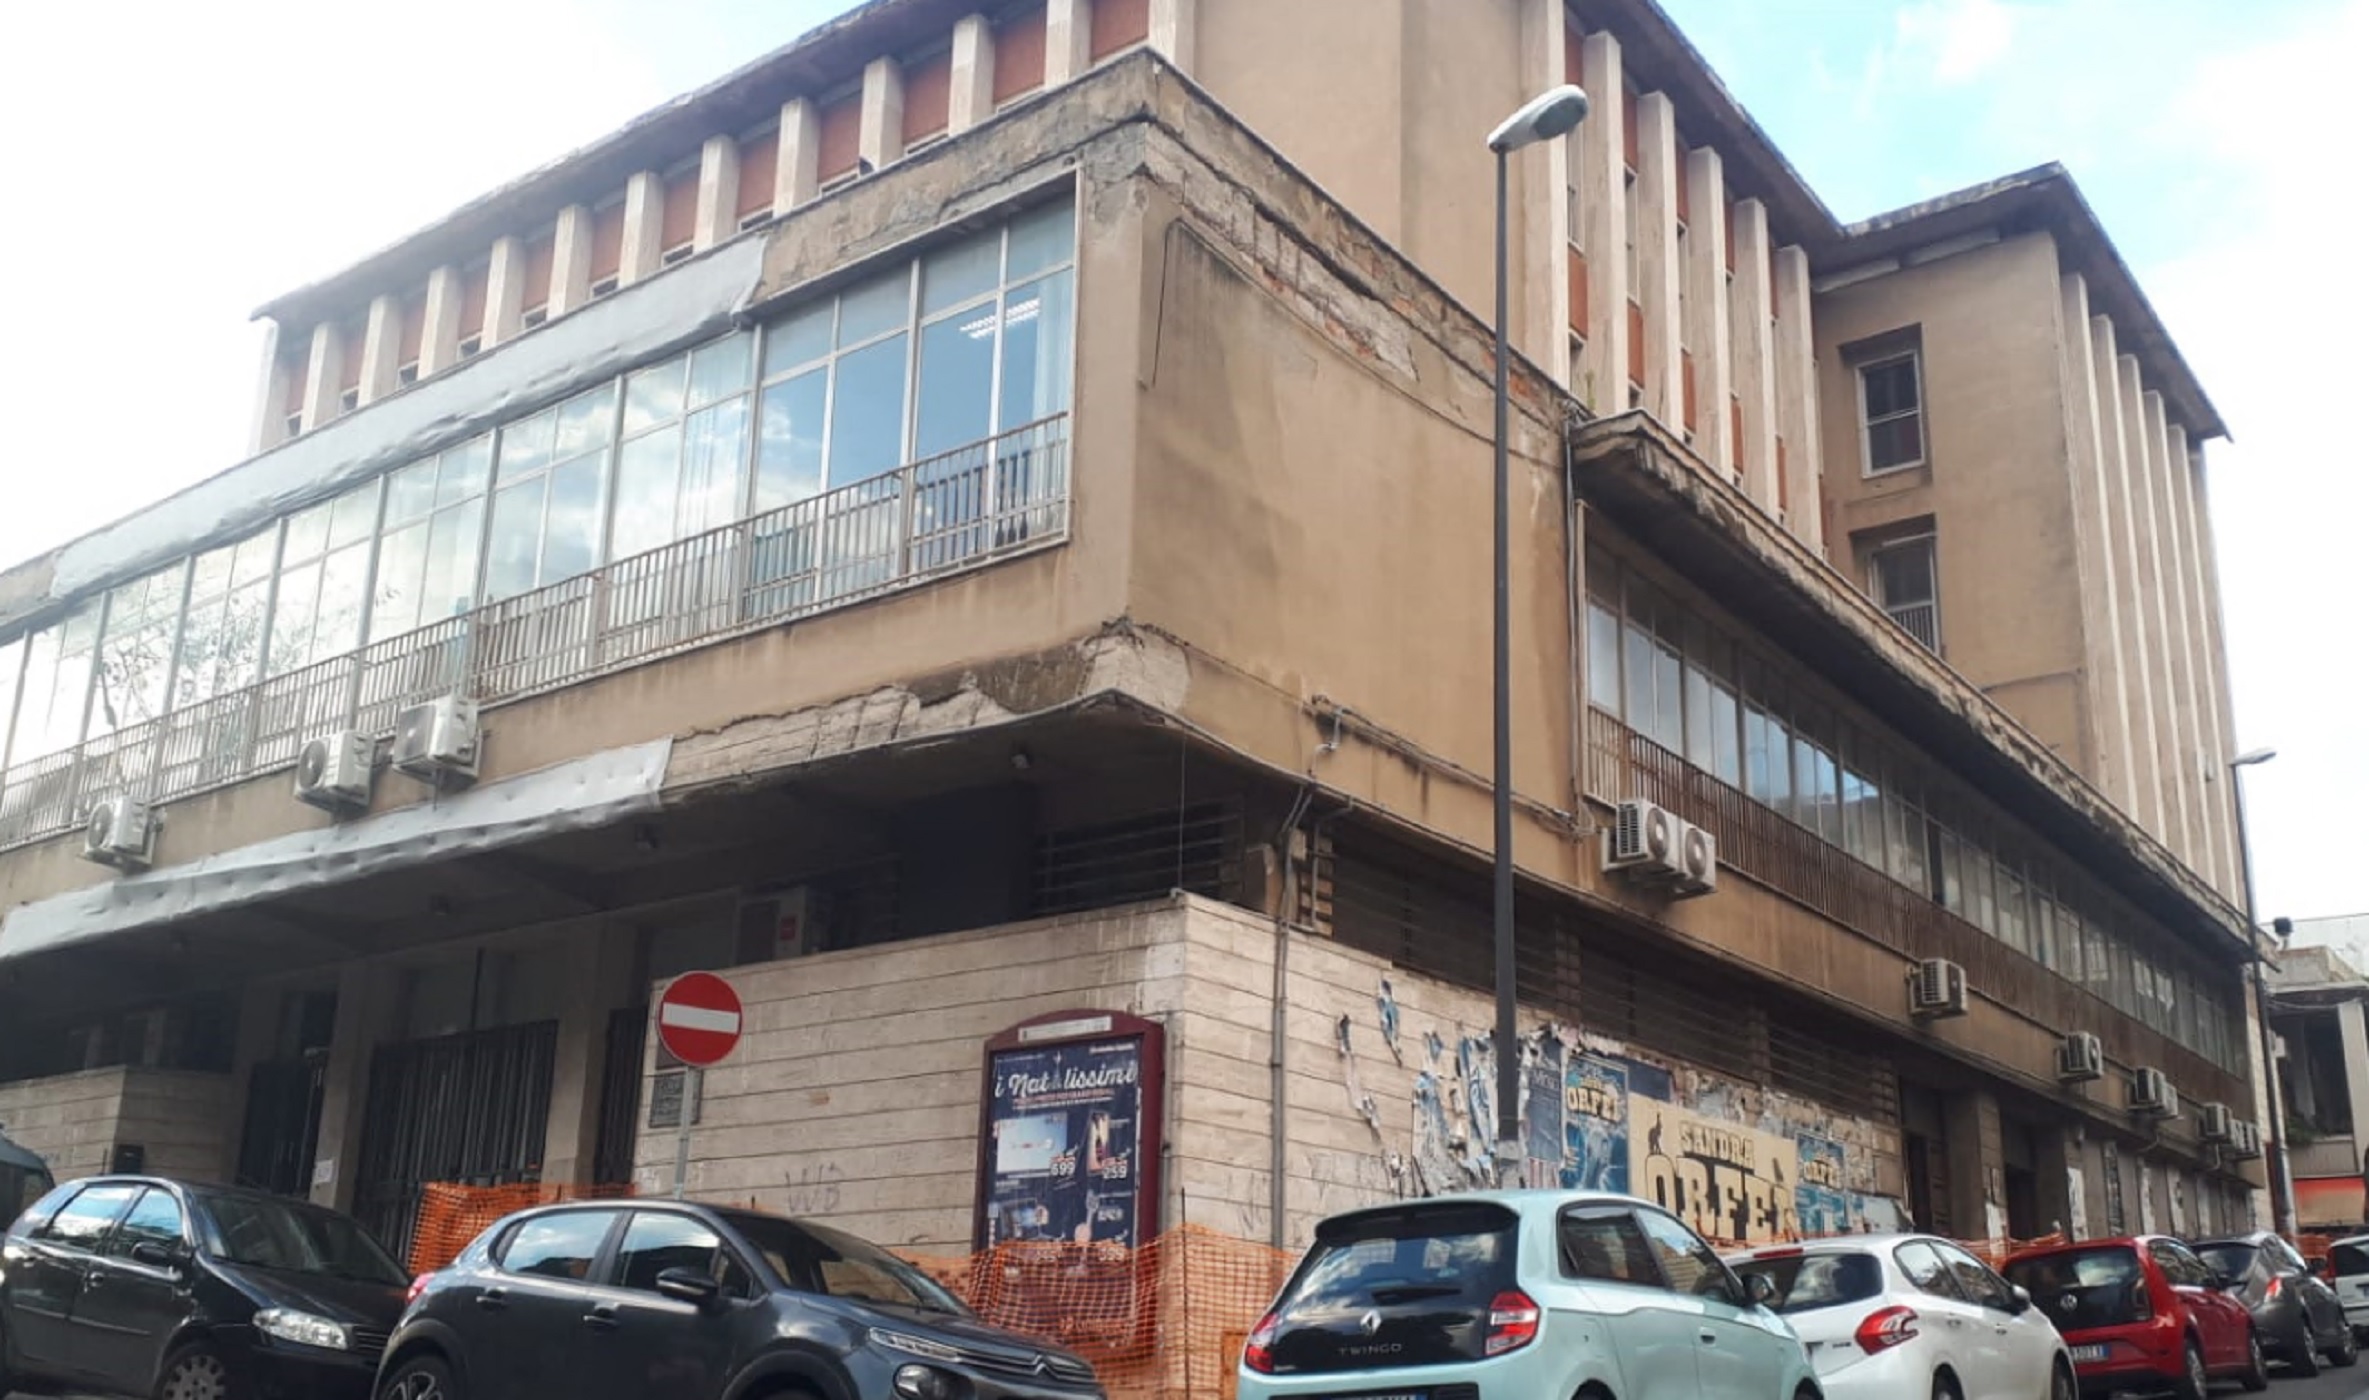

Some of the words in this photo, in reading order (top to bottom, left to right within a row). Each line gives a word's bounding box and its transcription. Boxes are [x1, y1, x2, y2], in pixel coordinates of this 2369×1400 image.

[1680, 1121, 1755, 1170] SANDRA
[1051, 1161, 1075, 1177] 699
[1338, 1343, 1403, 1356] TWINGO
